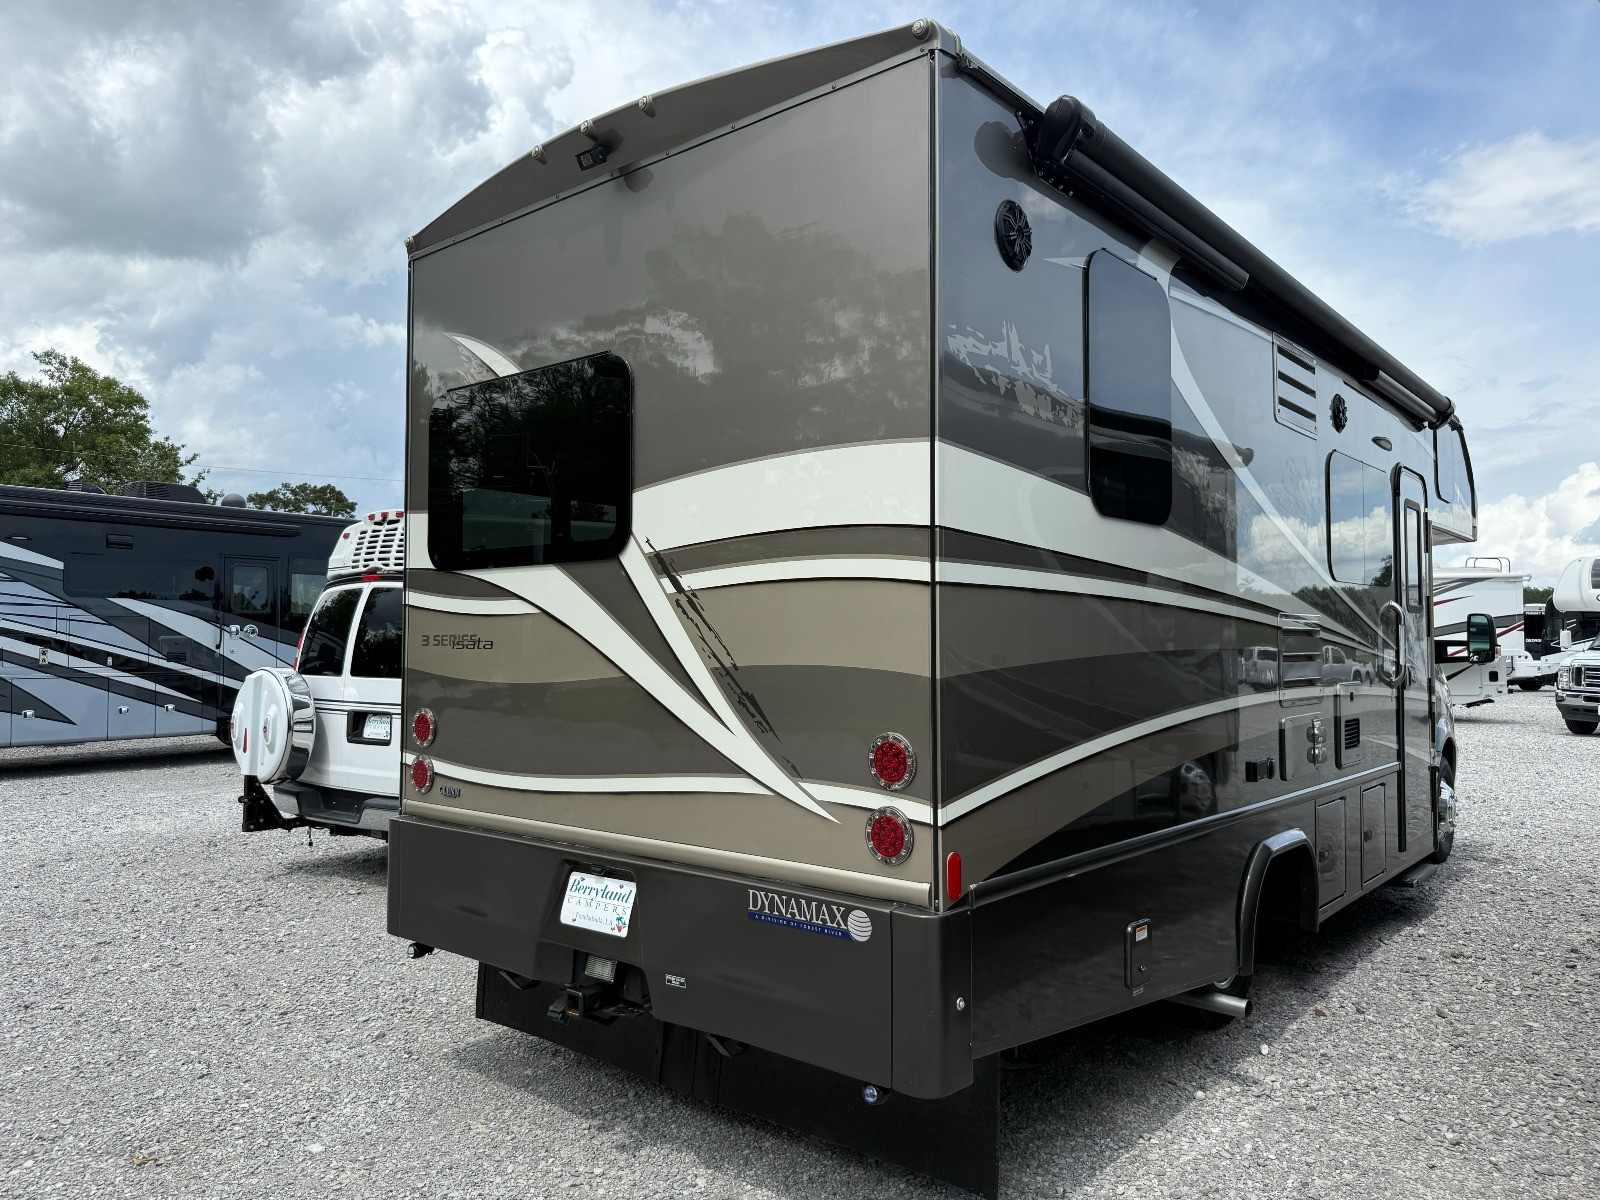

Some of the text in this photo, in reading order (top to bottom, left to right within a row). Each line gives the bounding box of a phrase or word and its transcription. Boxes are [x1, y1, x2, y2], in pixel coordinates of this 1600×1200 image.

[421, 633, 478, 647] 3 SERIES
[451, 636, 494, 650] isata
[569, 878, 633, 904] Berryland
[567, 896, 627, 916] CAMPERS
[747, 888, 848, 930] DYNAMAX
[761, 915, 787, 925] DIVISION
[799, 923, 822, 932] FOREST
[824, 928, 842, 937] RIVER
